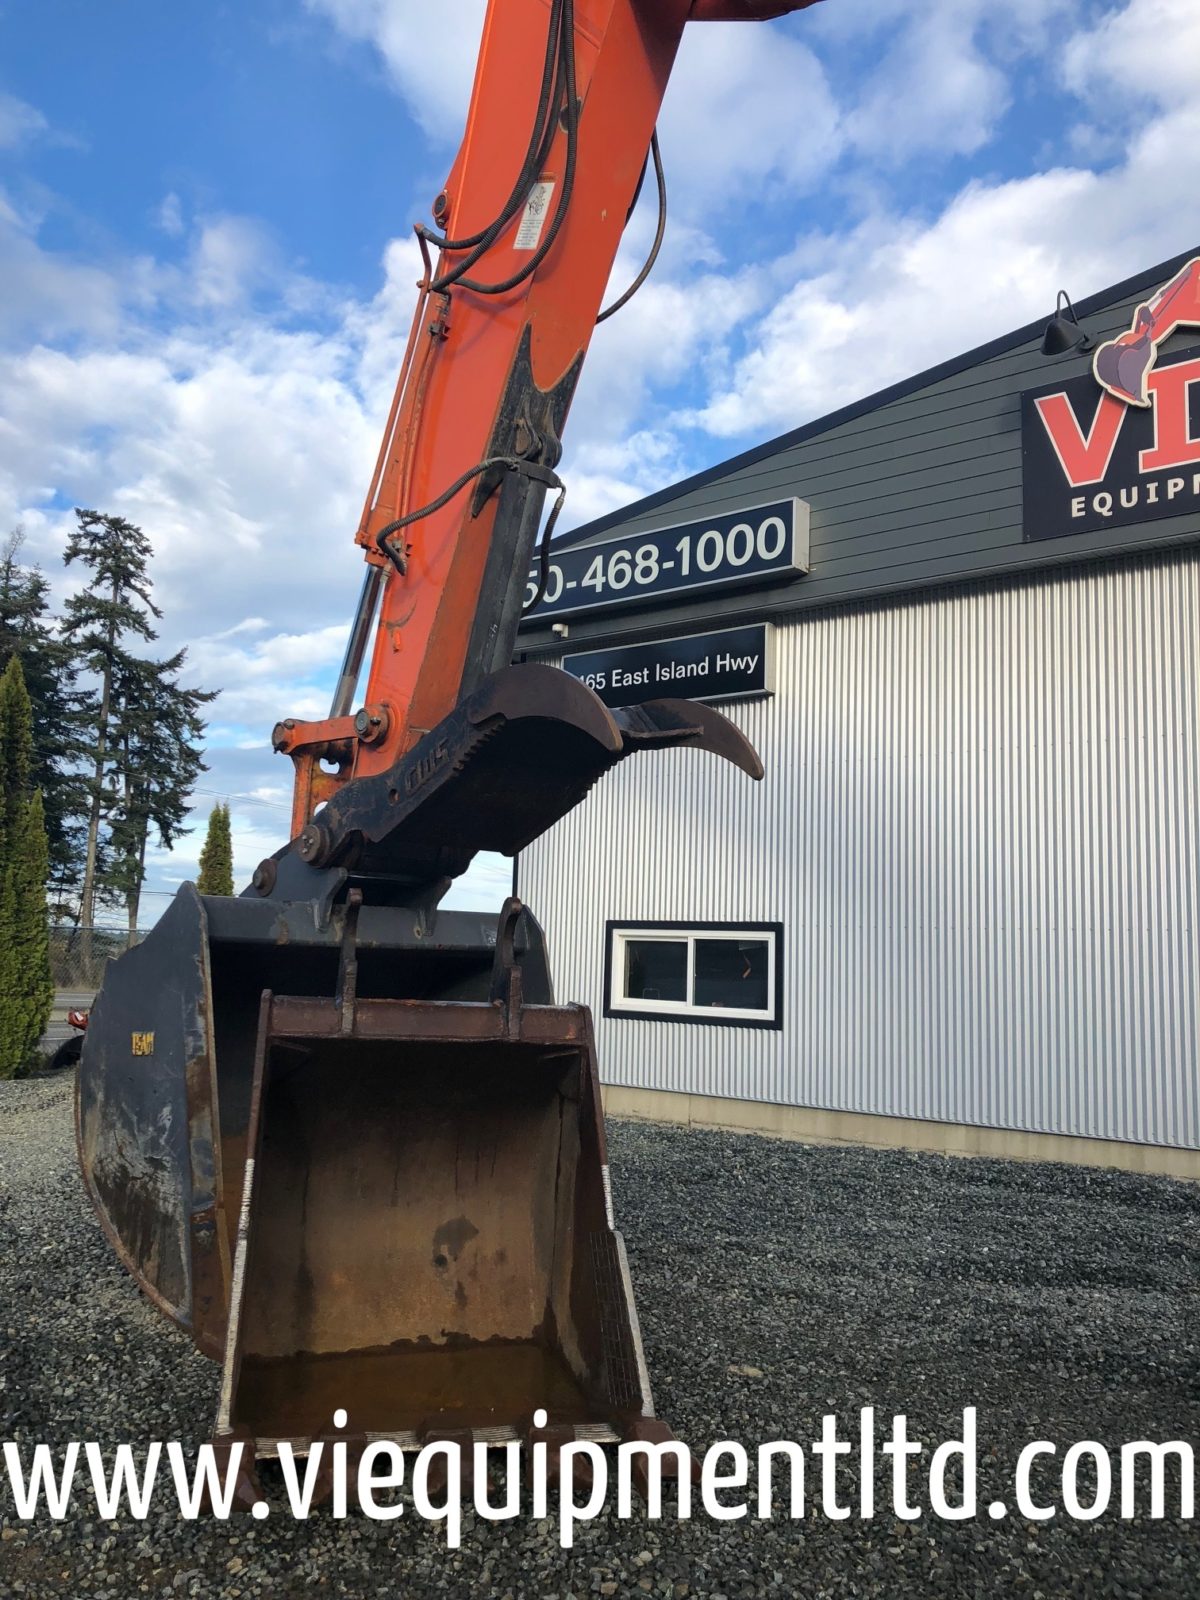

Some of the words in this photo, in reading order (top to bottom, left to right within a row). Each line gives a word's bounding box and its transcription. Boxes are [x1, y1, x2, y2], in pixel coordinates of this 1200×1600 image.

[580, 672, 606, 690] 65
[611, 667, 650, 688] East
[655, 656, 709, 682] Island
[716, 652, 759, 675] Hwy
